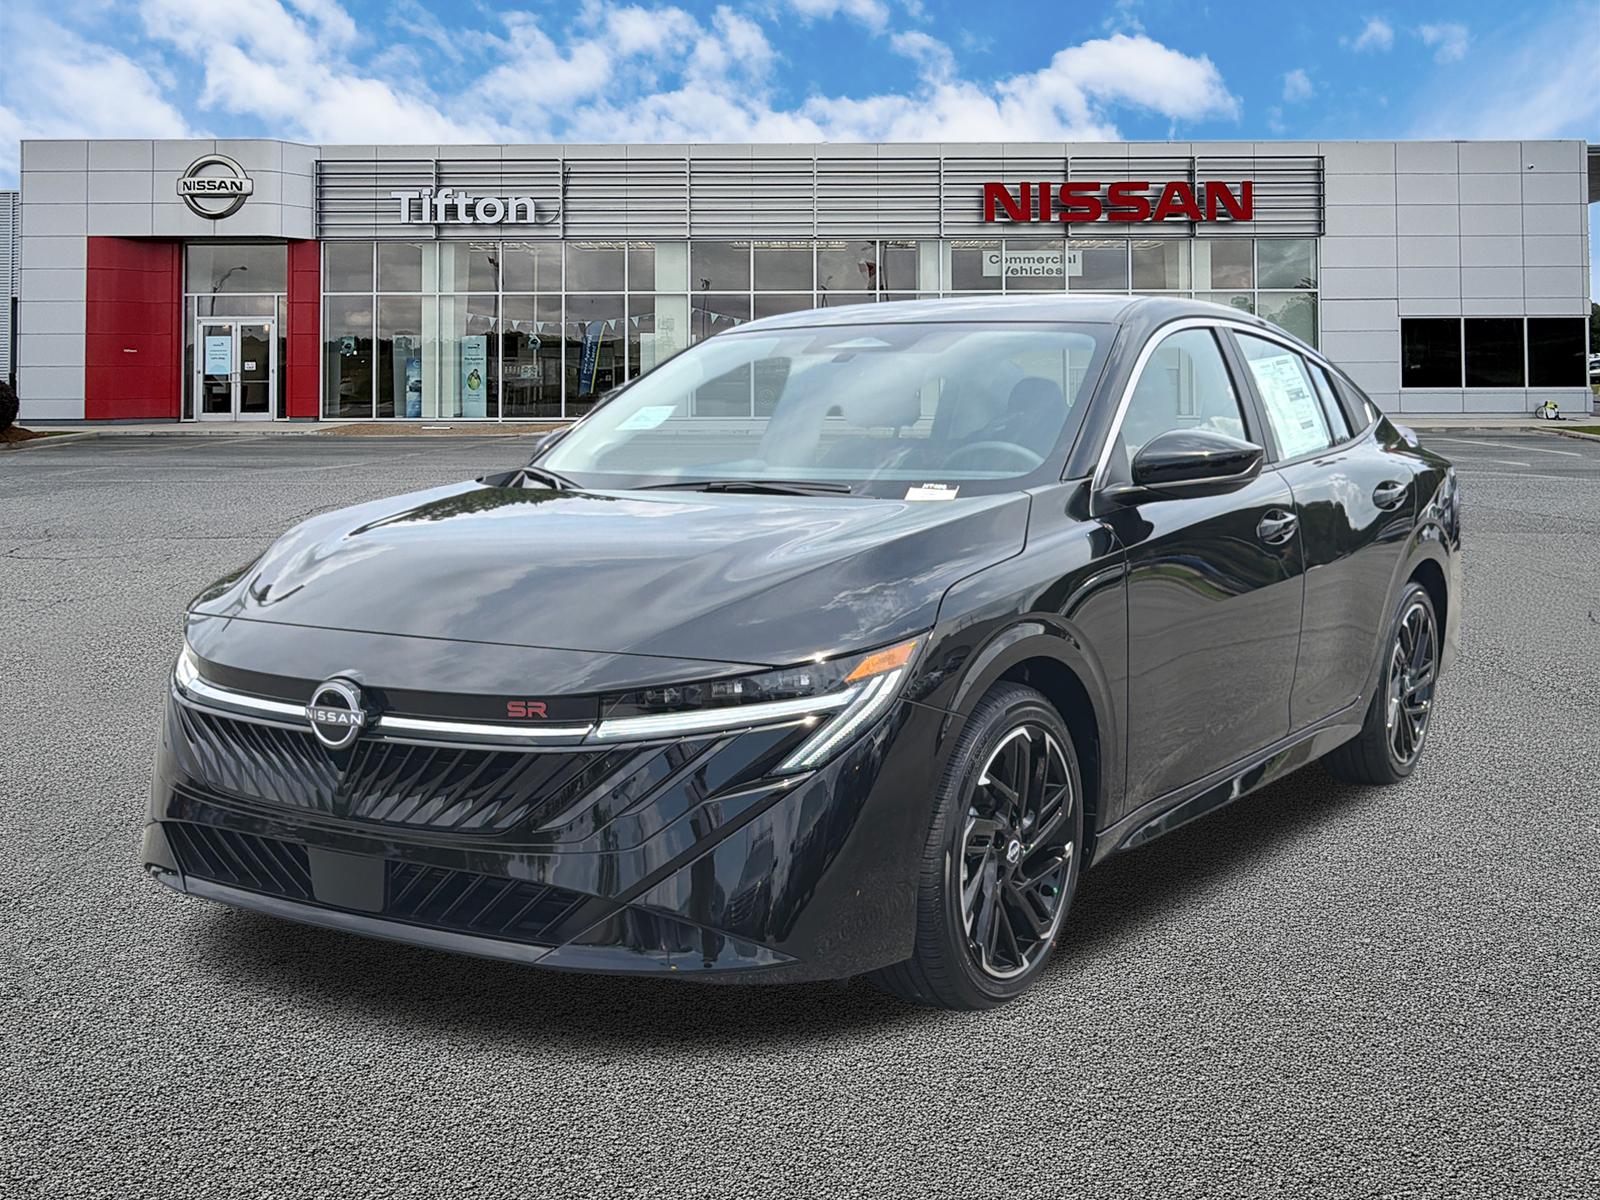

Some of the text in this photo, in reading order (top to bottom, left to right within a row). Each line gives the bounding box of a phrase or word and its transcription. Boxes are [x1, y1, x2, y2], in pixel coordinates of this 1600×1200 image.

[183, 181, 243, 191] NISSAN
[391, 188, 537, 224] Tifton
[983, 181, 1253, 222] NISSAN
[306, 708, 362, 725] NISSAN
[507, 701, 548, 718] SR
